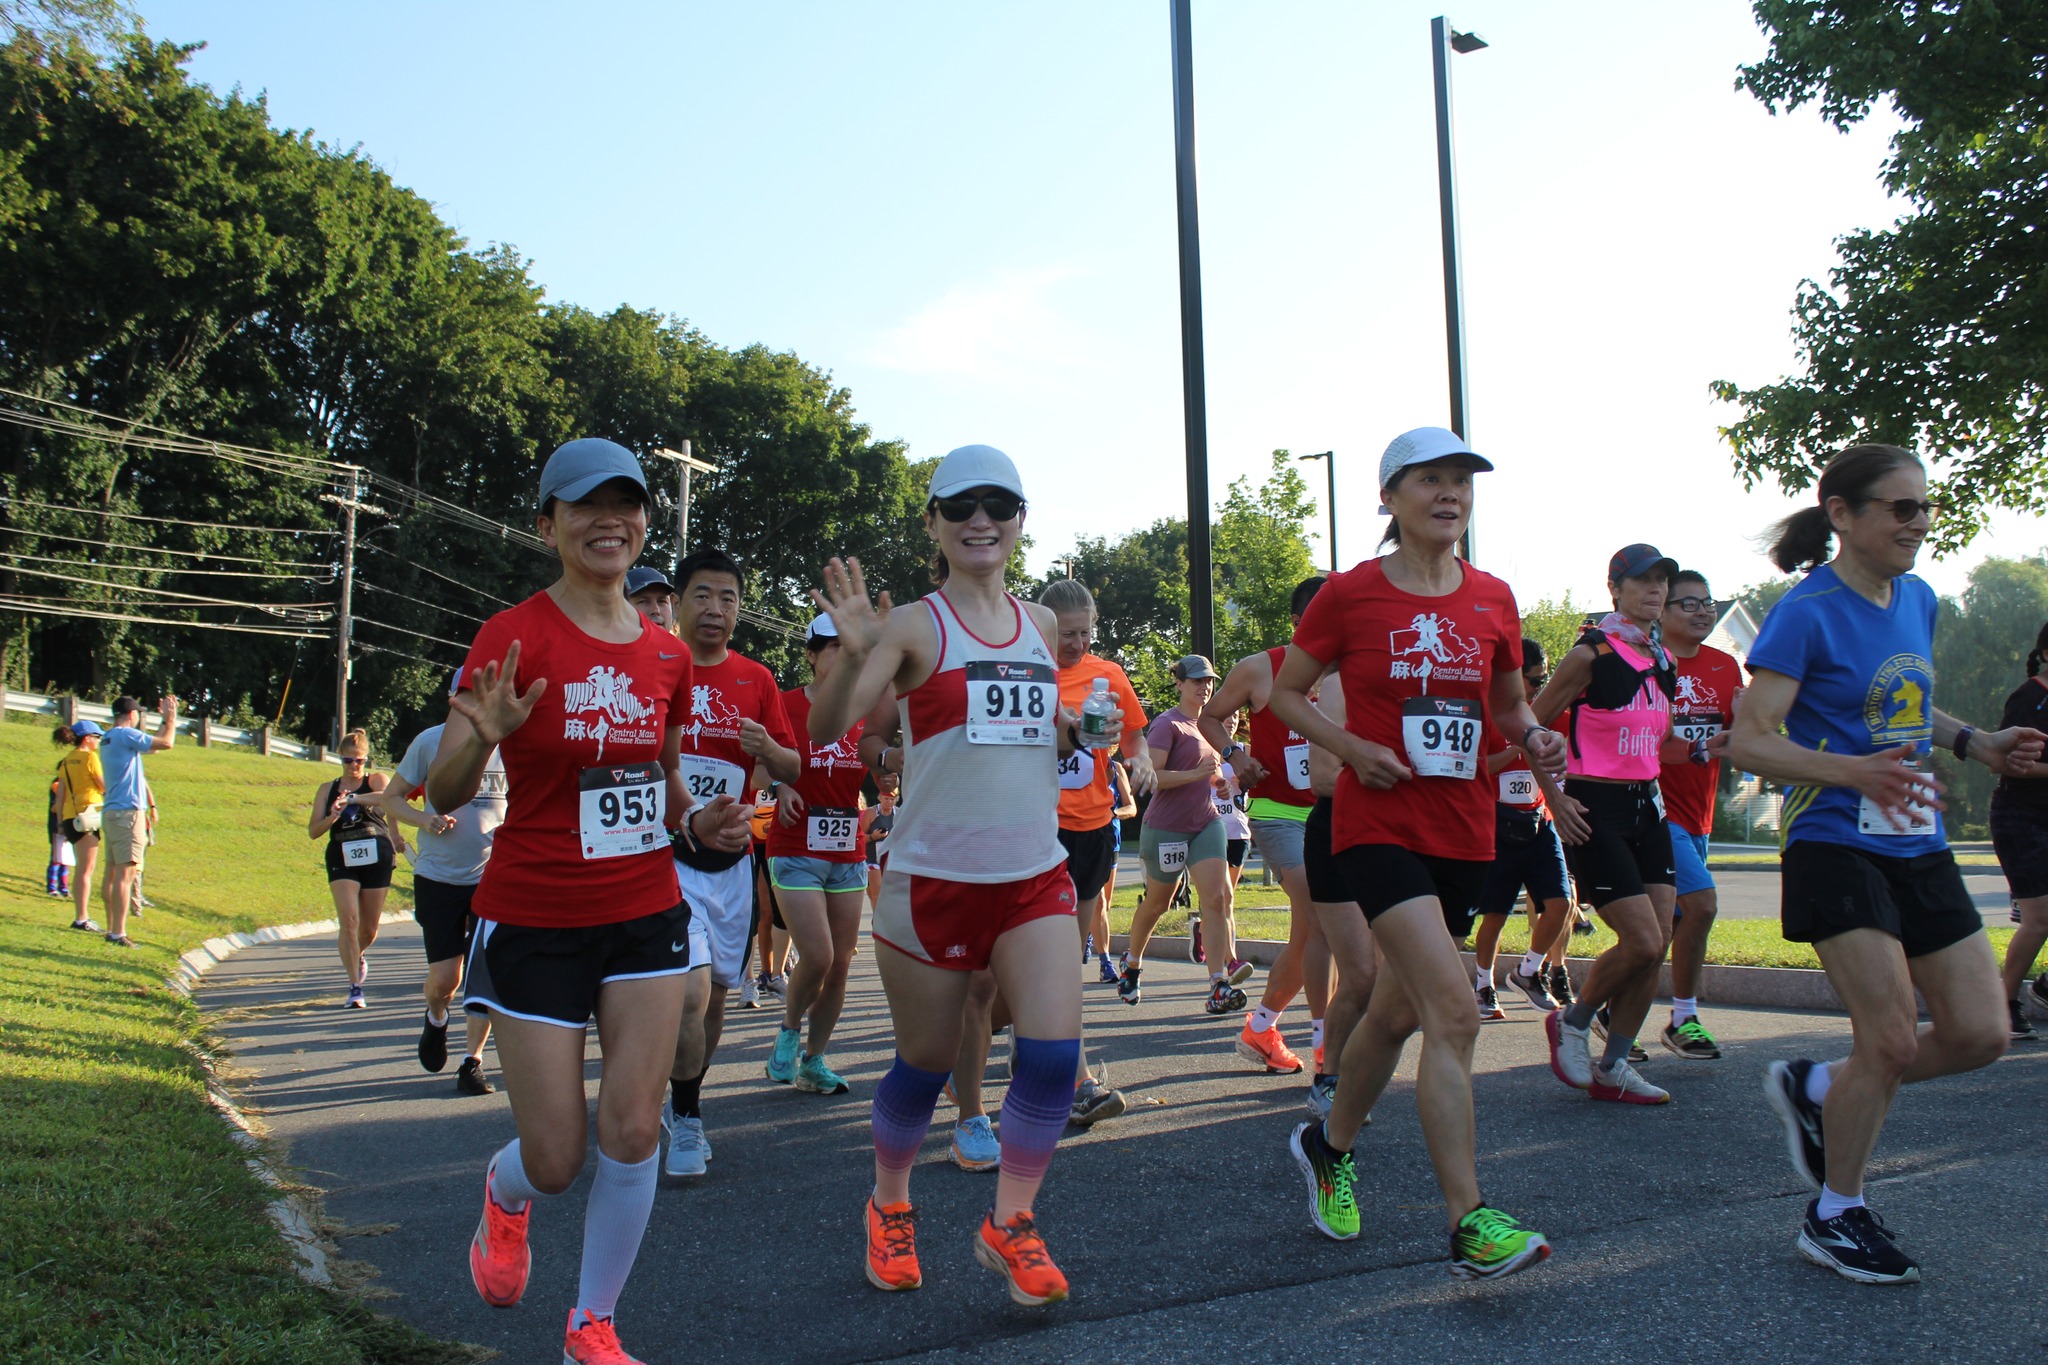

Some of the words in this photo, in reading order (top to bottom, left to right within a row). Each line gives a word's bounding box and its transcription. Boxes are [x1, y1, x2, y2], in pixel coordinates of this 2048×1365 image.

[1433, 666, 1463, 675] Central
[1464, 667, 1481, 676] Mass
[986, 684, 1045, 718] 918
[608, 728, 637, 737] Central
[638, 729, 655, 738] Mass
[608, 735, 633, 744] Chinese
[634, 737, 657, 745] Runners
[1422, 718, 1474, 753] 948
[1684, 726, 1715, 742] 926
[688, 774, 727, 797] 324
[1509, 781, 1531, 794] 320
[598, 787, 656, 828] 953
[604, 825, 655, 835] www.RoadID.com
[818, 819, 851, 837] 925
[350, 848, 368, 859] 321
[1164, 851, 1184, 865] 318
